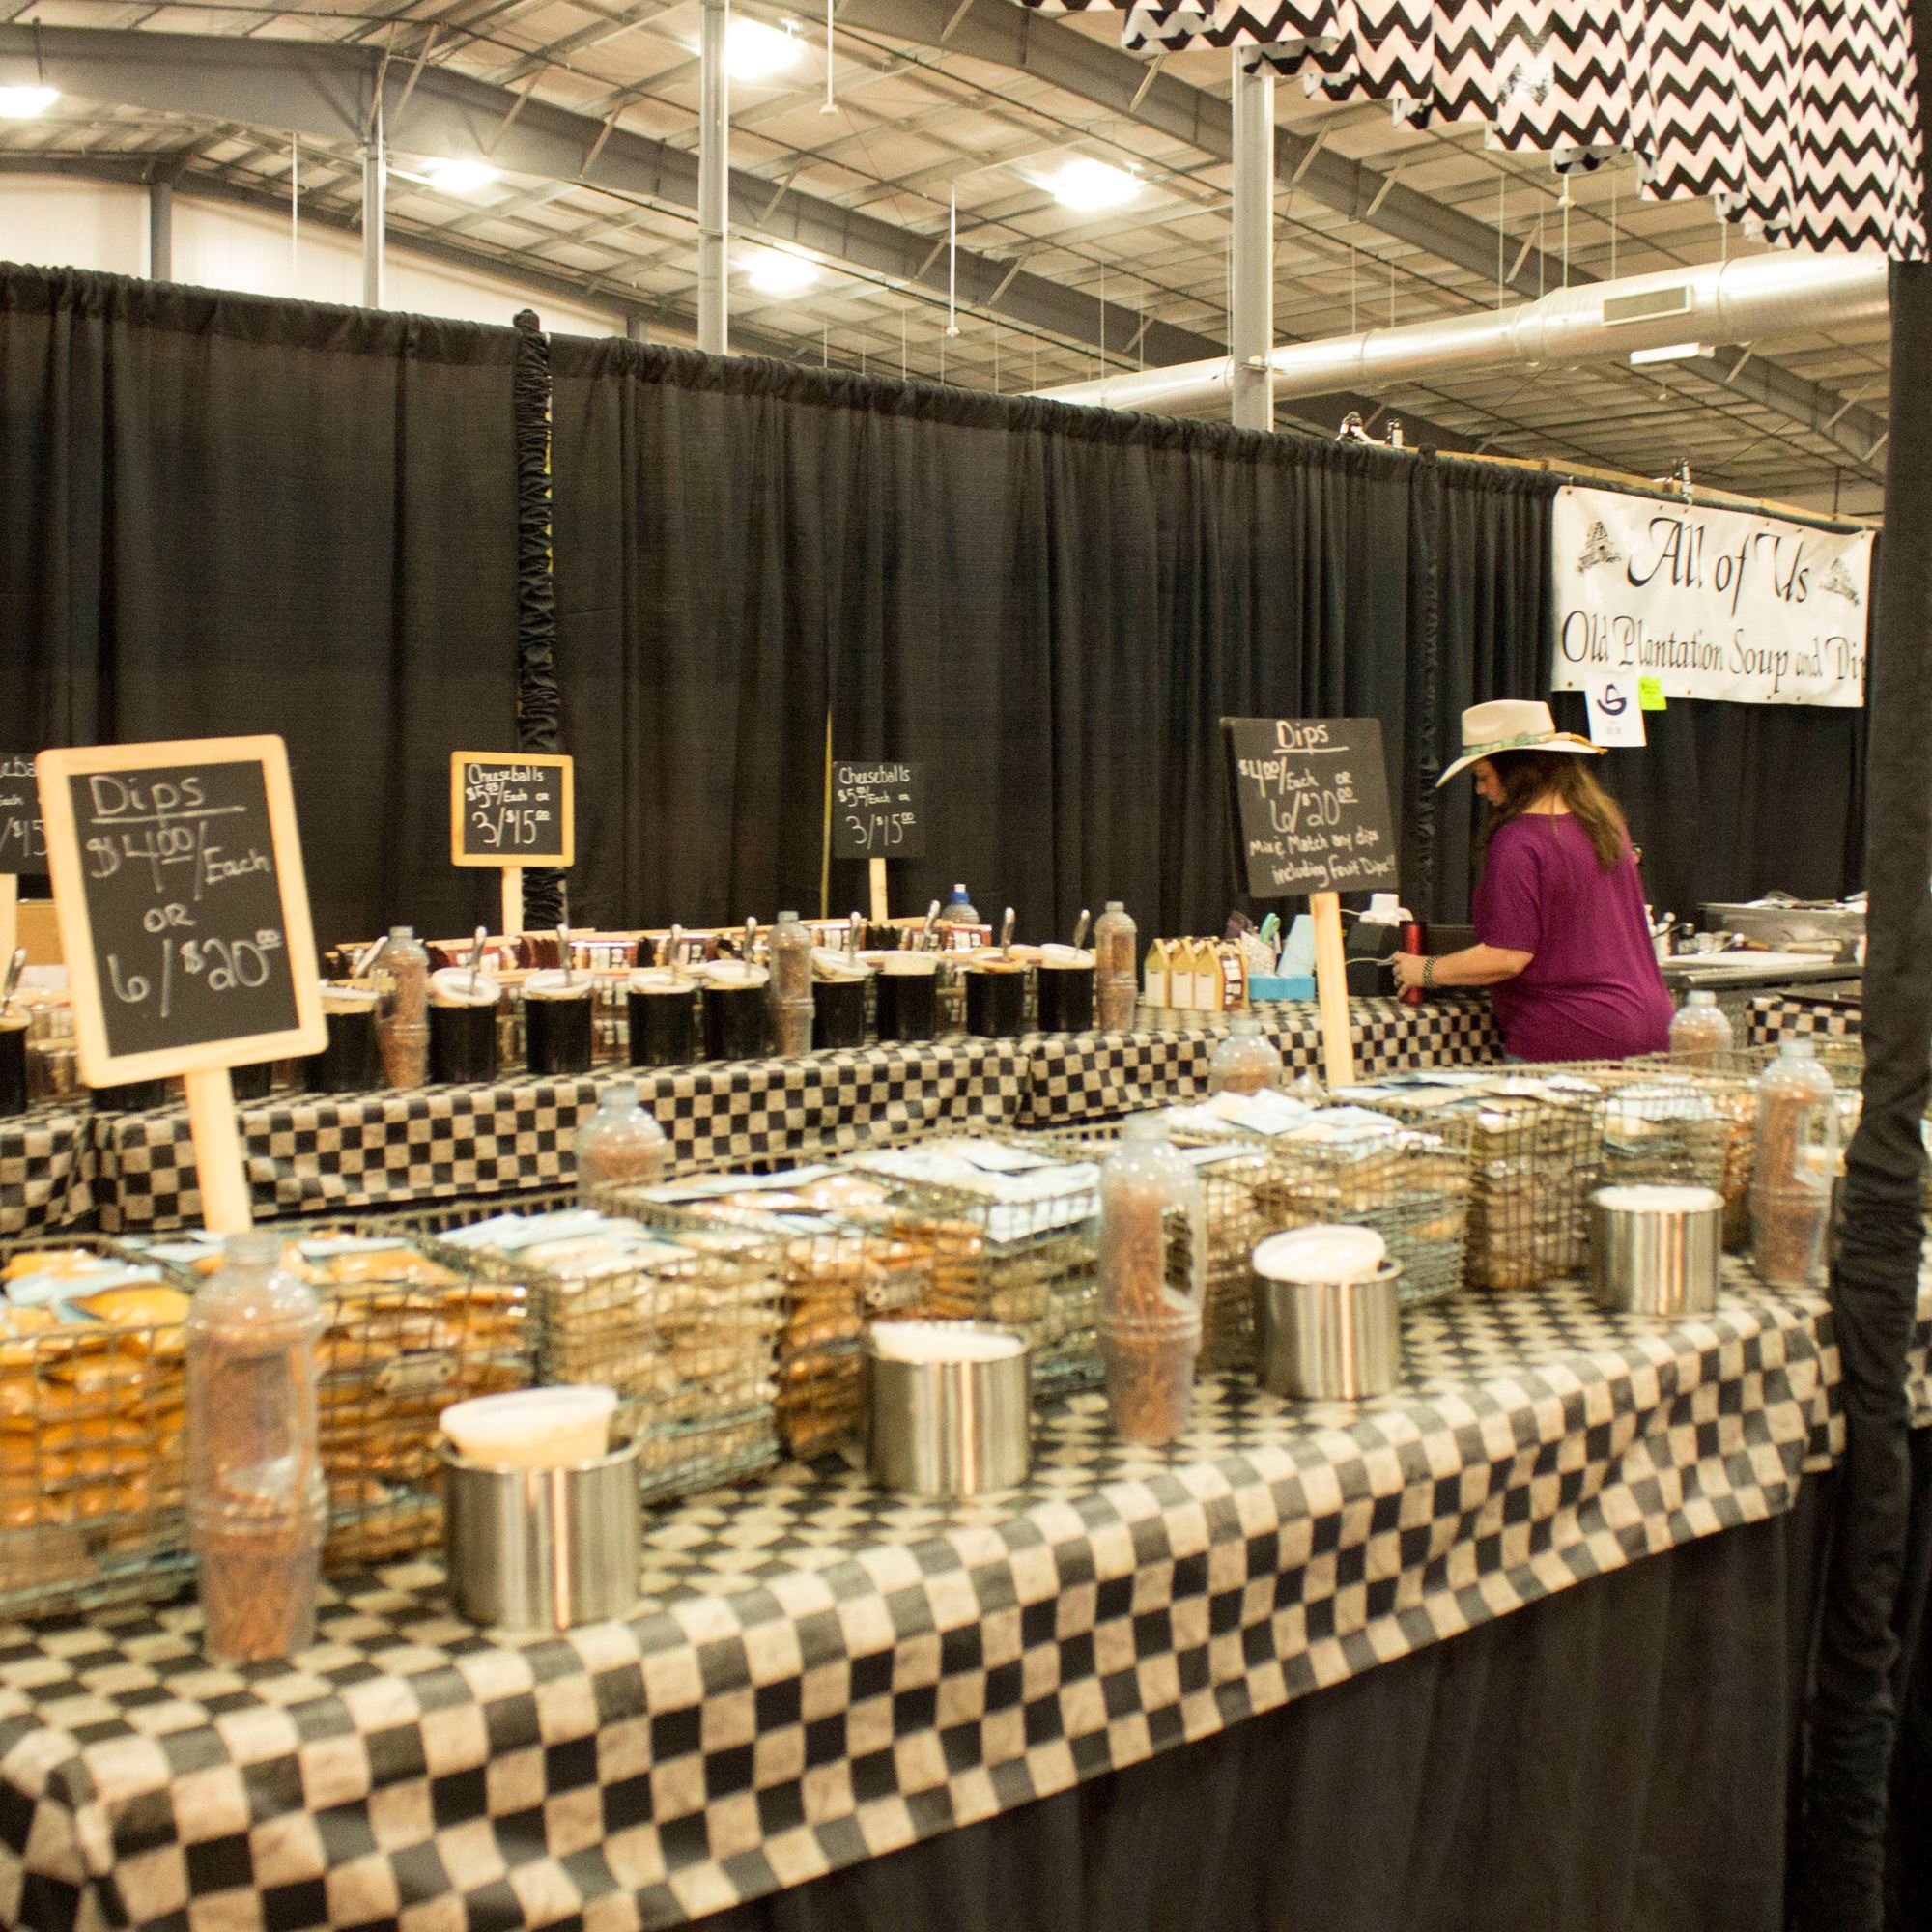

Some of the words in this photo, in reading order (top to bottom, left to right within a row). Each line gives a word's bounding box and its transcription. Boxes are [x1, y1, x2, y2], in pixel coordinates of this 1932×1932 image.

[1627, 517, 1705, 588] All
[1715, 534, 1750, 618] of
[1754, 532, 1809, 603] Us
[1562, 610, 1608, 663] Old
[1613, 615, 1723, 672] Plantation
[1729, 628, 1788, 694] Soup
[1276, 720, 1329, 754] Dips
[89, 775, 206, 828] Dips
